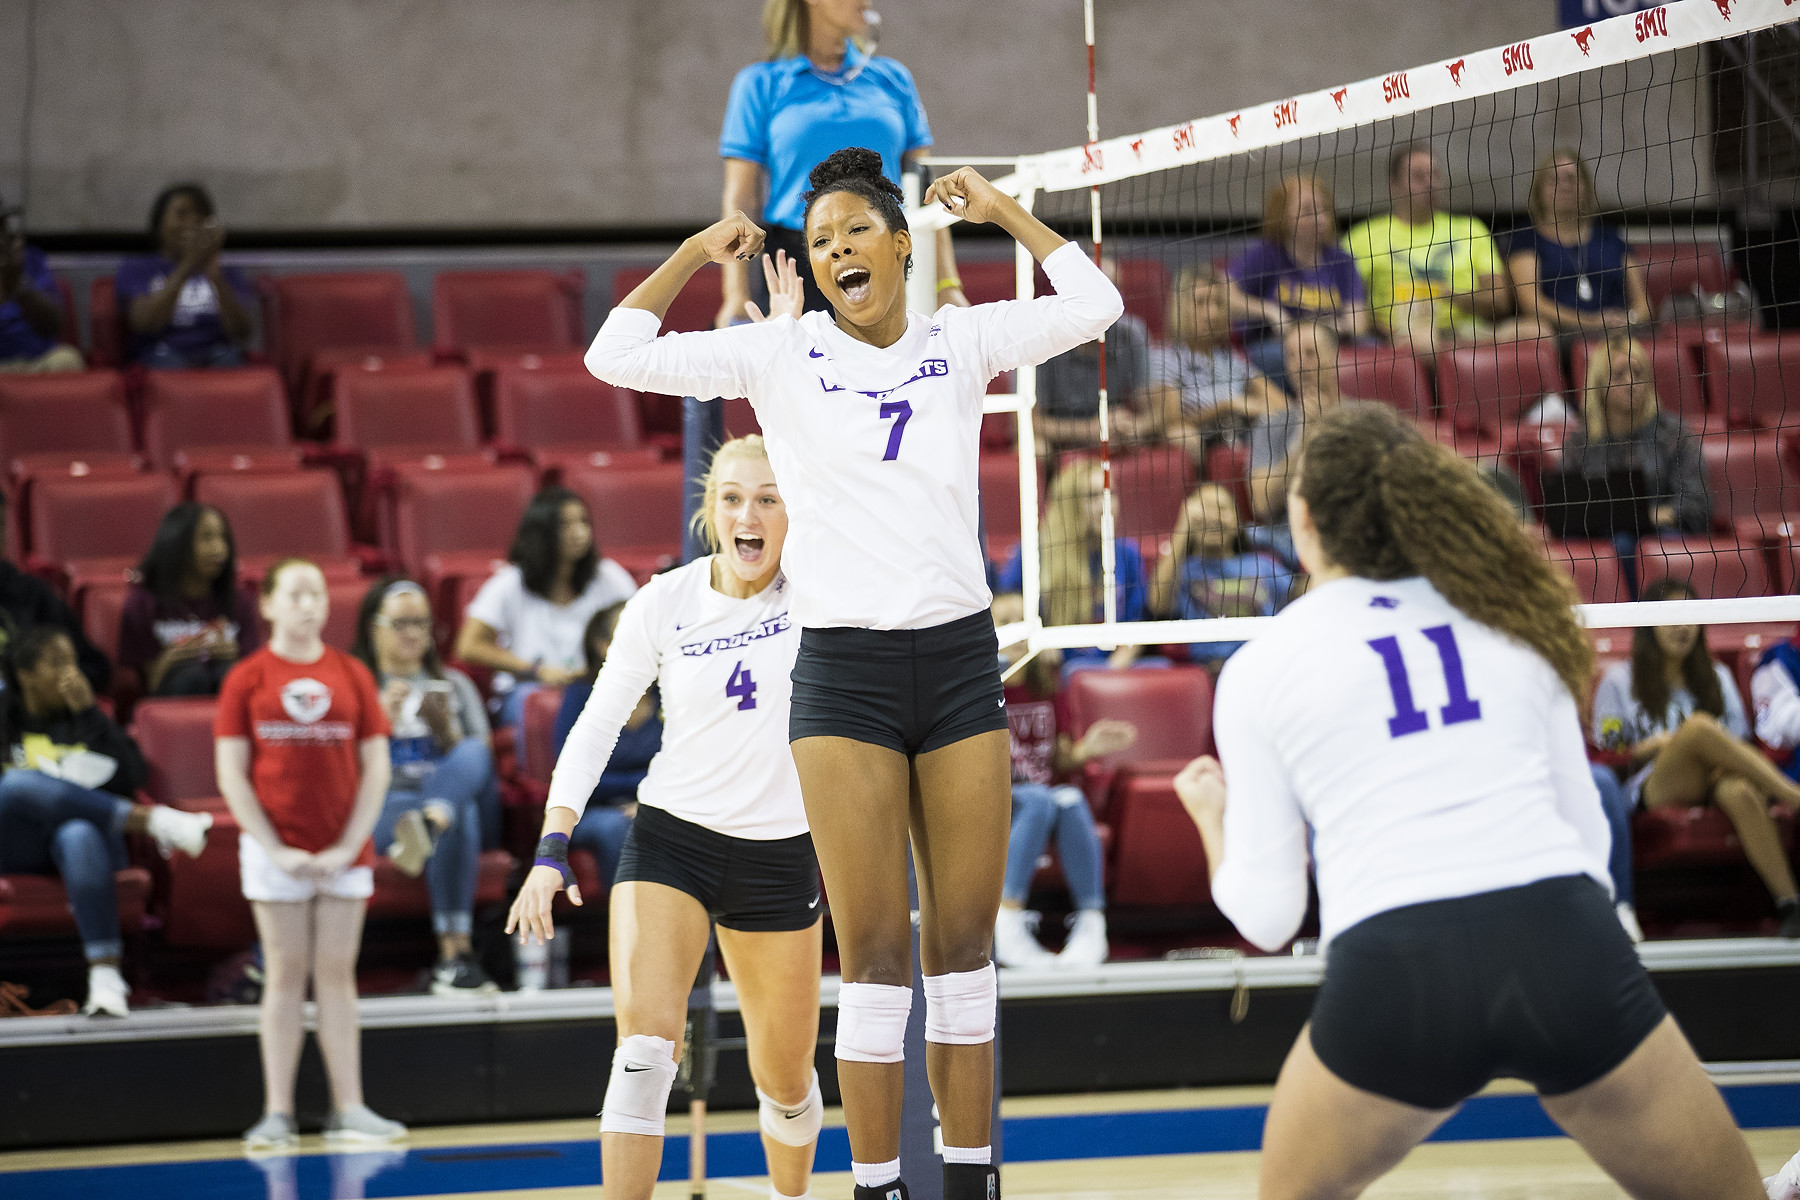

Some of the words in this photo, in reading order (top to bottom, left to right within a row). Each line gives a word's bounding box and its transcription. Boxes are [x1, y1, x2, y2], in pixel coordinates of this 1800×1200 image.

[1383, 72, 1410, 104] SMU
[1502, 43, 1534, 76] SMU
[1634, 7, 1669, 43] SMU
[880, 400, 913, 461] 7
[681, 611, 792, 656] WILDCATS
[726, 660, 757, 711] 4
[1366, 624, 1482, 738] 11
